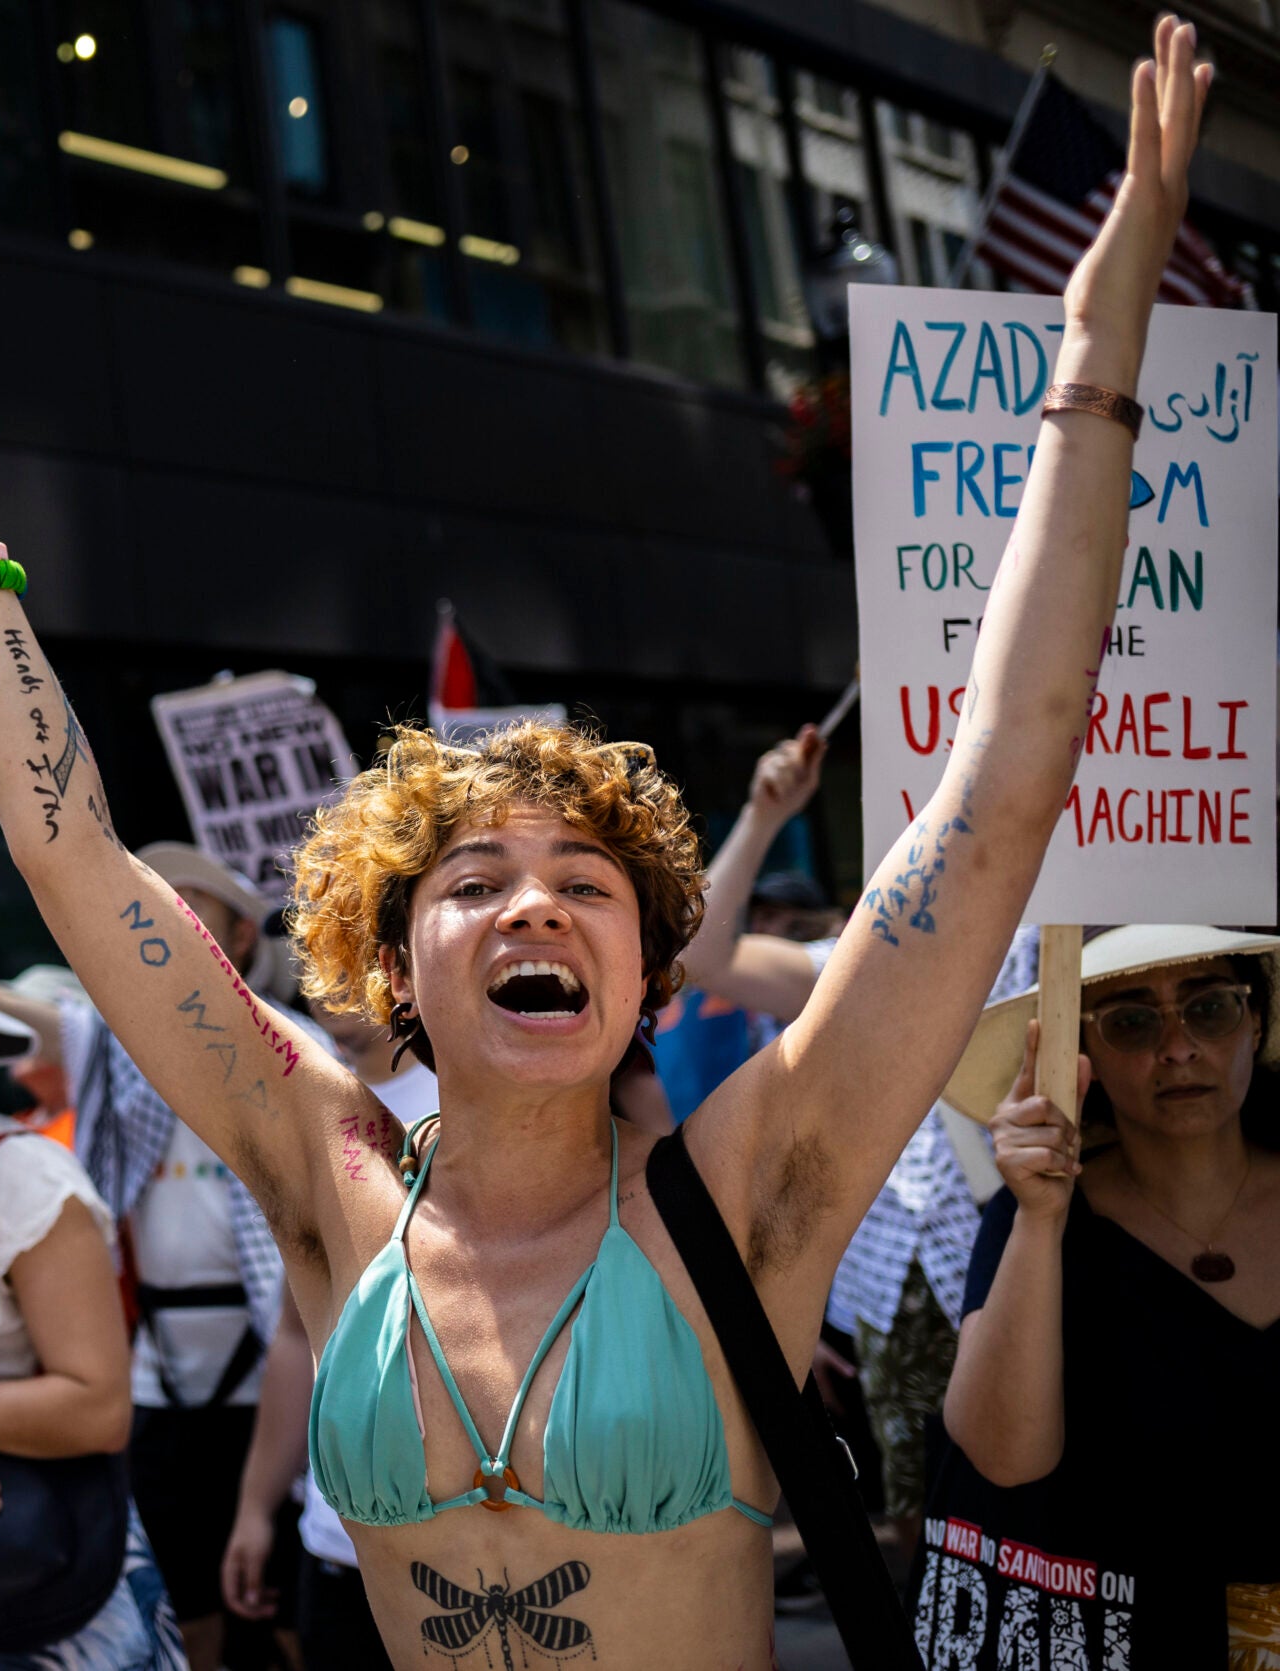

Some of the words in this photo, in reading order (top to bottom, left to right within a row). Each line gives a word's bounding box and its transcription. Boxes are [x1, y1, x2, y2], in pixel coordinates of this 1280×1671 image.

[879, 319, 1065, 416] AZAD
[911, 440, 1210, 528] FREM
[896, 543, 992, 592] FOR
[1108, 624, 1146, 657] HE
[1086, 691, 1249, 760] RAELI
[193, 752, 290, 813] WAR
[120, 900, 172, 968] NO
[339, 1115, 368, 1181] IRAN
[925, 1517, 946, 1548] NO
[946, 1522, 978, 1559] WAR
[979, 1534, 996, 1567] NO
[1101, 1571, 1135, 1605] ON
